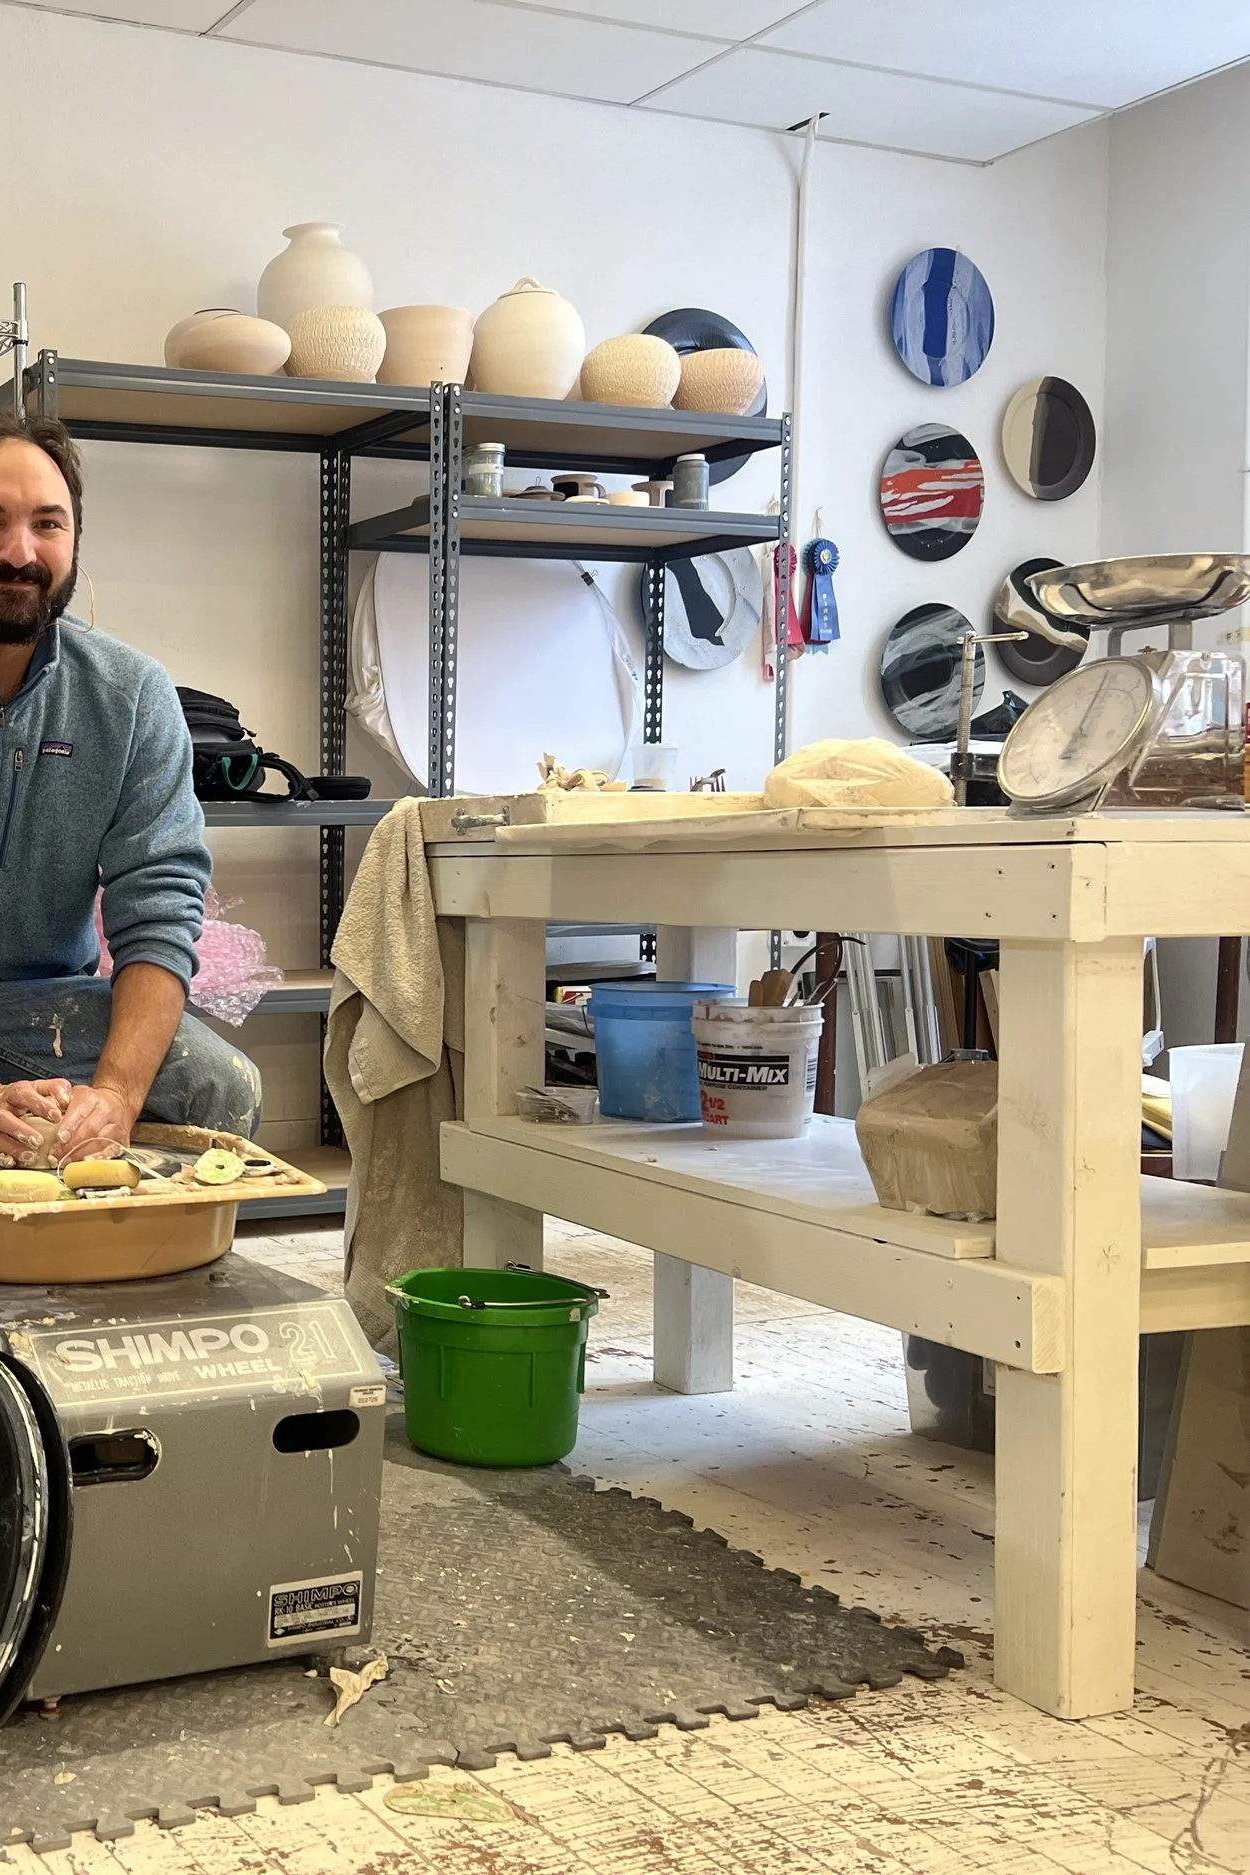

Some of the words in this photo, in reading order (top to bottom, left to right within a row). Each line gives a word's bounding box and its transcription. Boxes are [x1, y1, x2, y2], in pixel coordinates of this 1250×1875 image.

[55, 1323, 269, 1373] SHIMPO
[279, 1320, 338, 1363] 21
[70, 1377, 110, 1392] METALLIC
[112, 1371, 152, 1388] TRACTION
[157, 1371, 182, 1383] DRIVE
[192, 1358, 282, 1380] WHEEL
[274, 1582, 358, 1607] SHIMPO
[295, 1602, 312, 1612] BASIC
